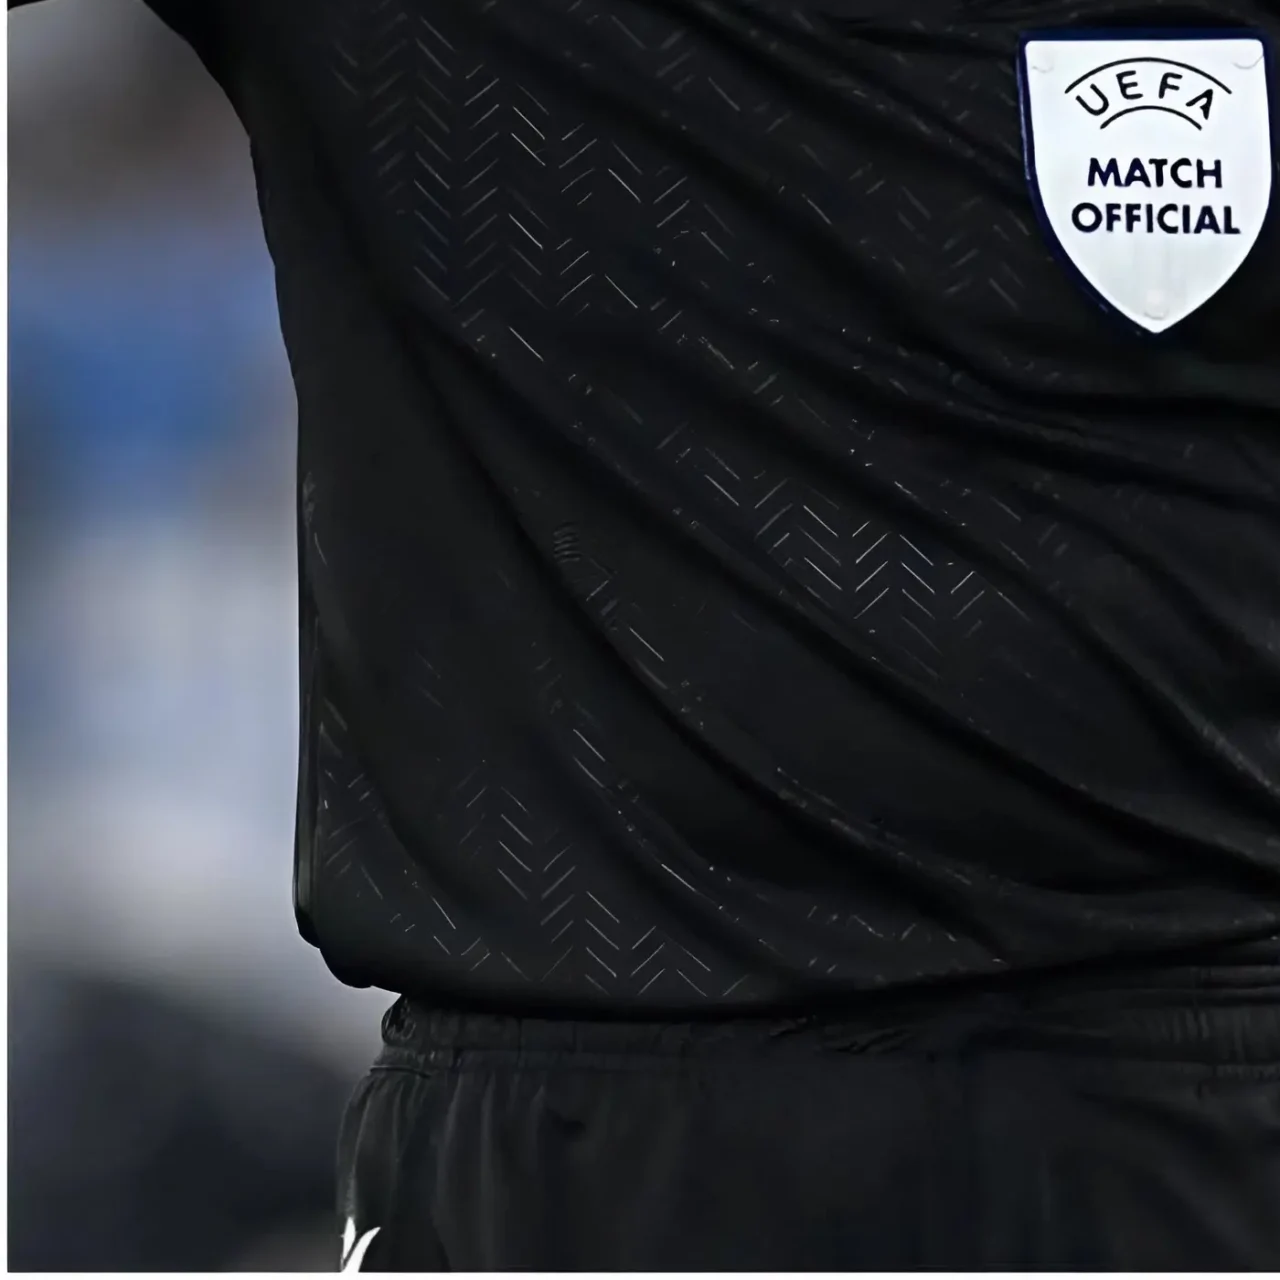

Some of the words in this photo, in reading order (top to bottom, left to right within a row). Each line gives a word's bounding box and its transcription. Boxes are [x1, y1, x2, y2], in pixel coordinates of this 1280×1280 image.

[1076, 70, 1214, 120] UEFA
[1087, 157, 1222, 189] MATCH
[1071, 202, 1241, 235] OFFICIAL
